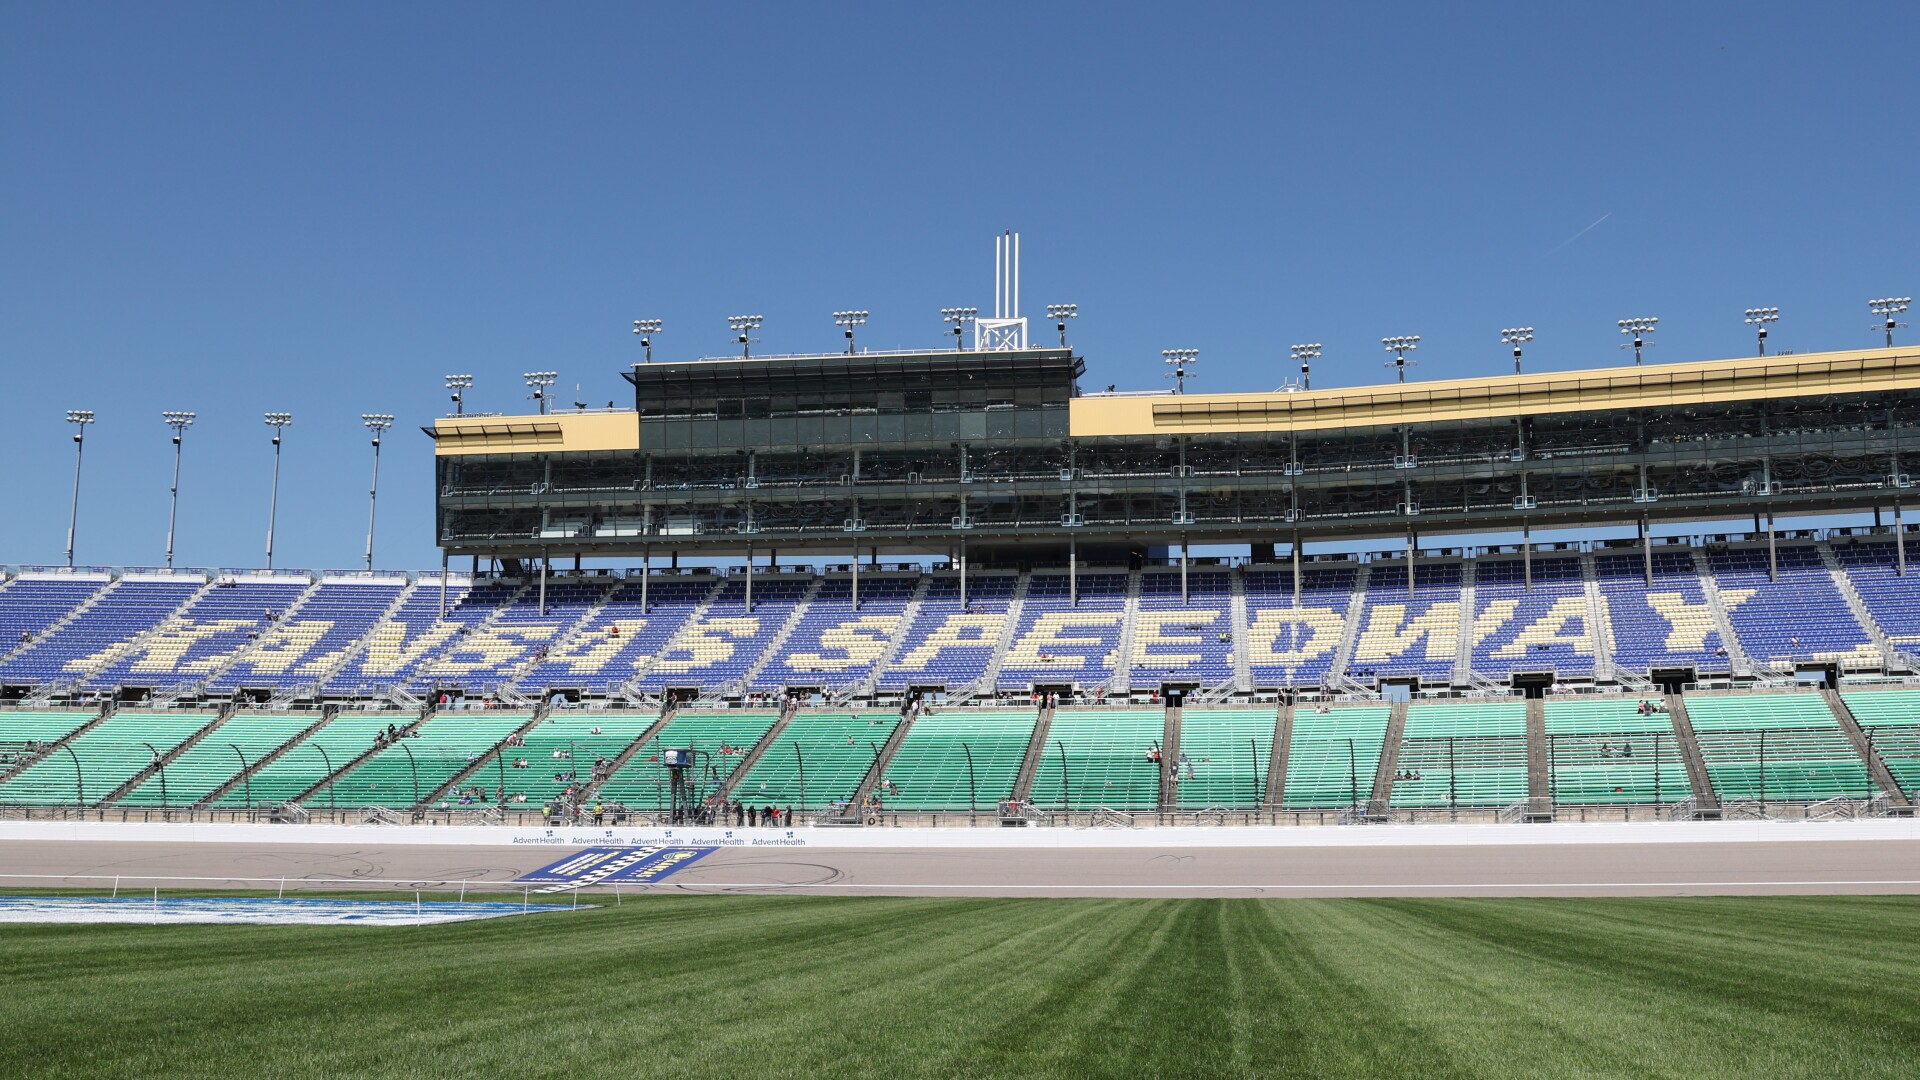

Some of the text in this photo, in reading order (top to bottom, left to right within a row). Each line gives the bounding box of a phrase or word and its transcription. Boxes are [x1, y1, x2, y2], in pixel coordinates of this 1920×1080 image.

[62, 588, 1758, 674] KANSAS SPEEDWAY
[513, 836, 565, 844] AdventHealth
[572, 836, 624, 845] AdventHealth
[631, 837, 684, 845] AdventHealth
[691, 838, 744, 846] AdventHealth
[752, 838, 806, 846] AdventHealth
